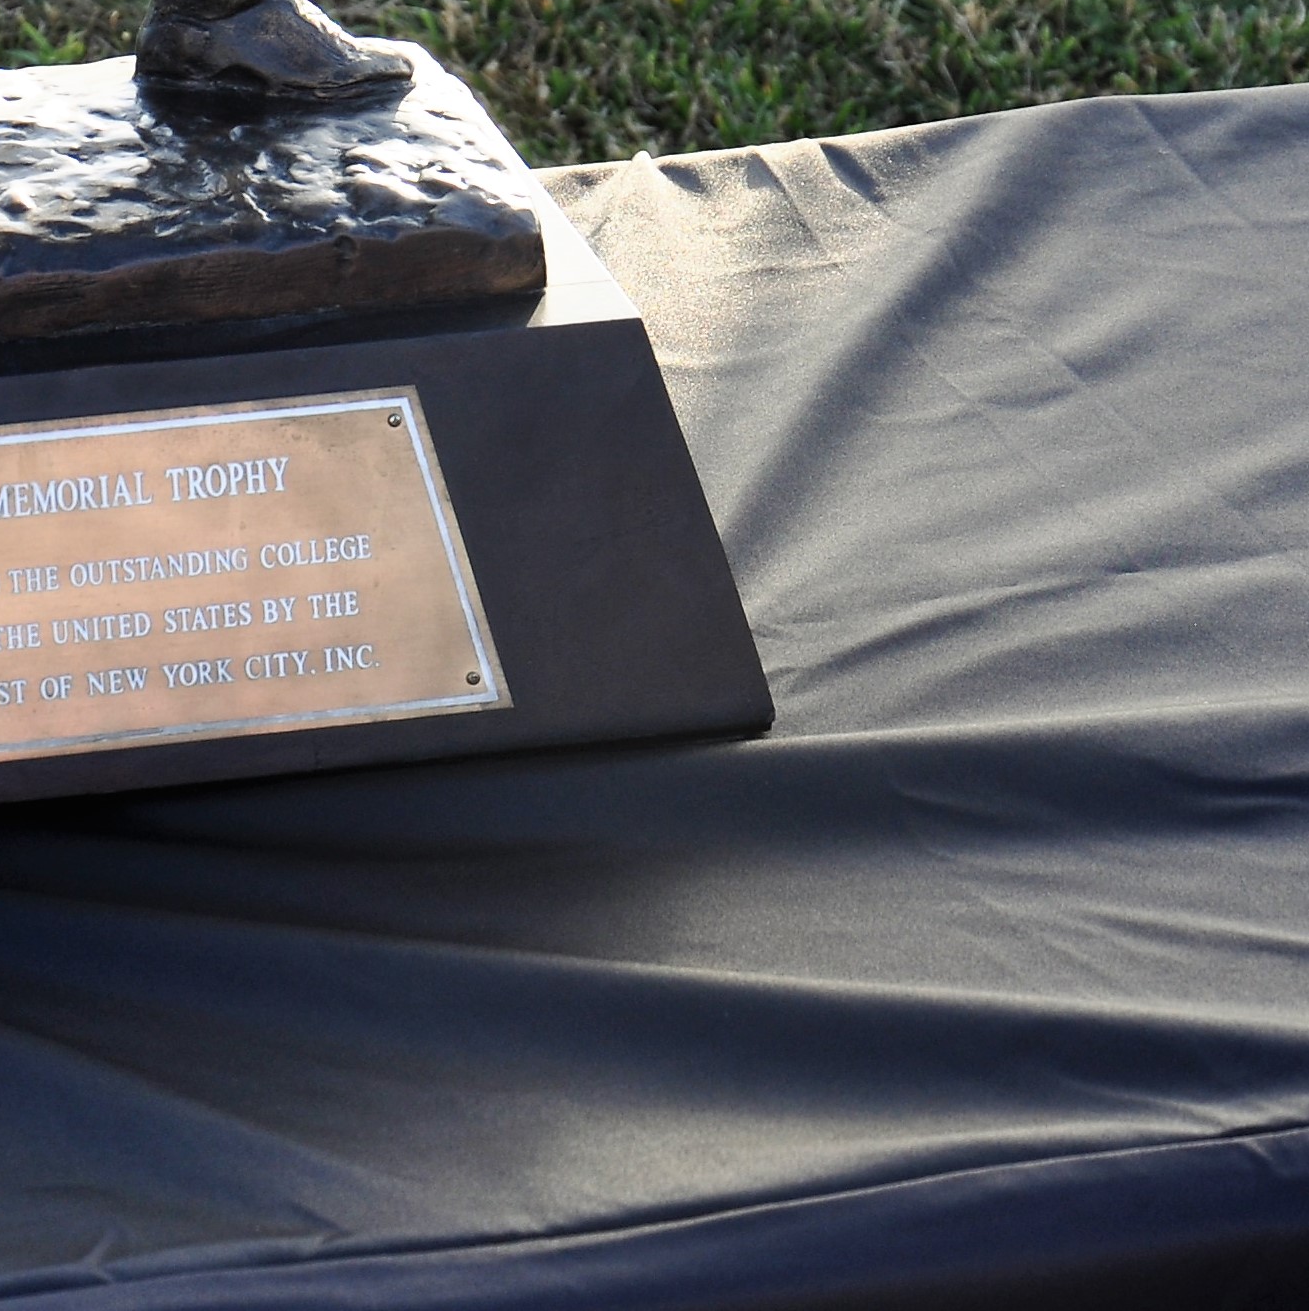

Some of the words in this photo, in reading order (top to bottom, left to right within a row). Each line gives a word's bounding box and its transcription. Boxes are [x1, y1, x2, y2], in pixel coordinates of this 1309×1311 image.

[165, 456, 289, 502] TROPHY
[8, 566, 59, 593] THE
[69, 547, 249, 586] OUTSTANDING
[259, 534, 372, 568] COLLEGE
[52, 612, 152, 645] UNITED
[164, 601, 253, 633] STATES
[262, 596, 296, 624] BY
[307, 590, 360, 618] THE
[40, 675, 72, 701] OF
[87, 666, 148, 696] NEW
[162, 658, 235, 689] YORK
[324, 644, 380, 673] INC.
